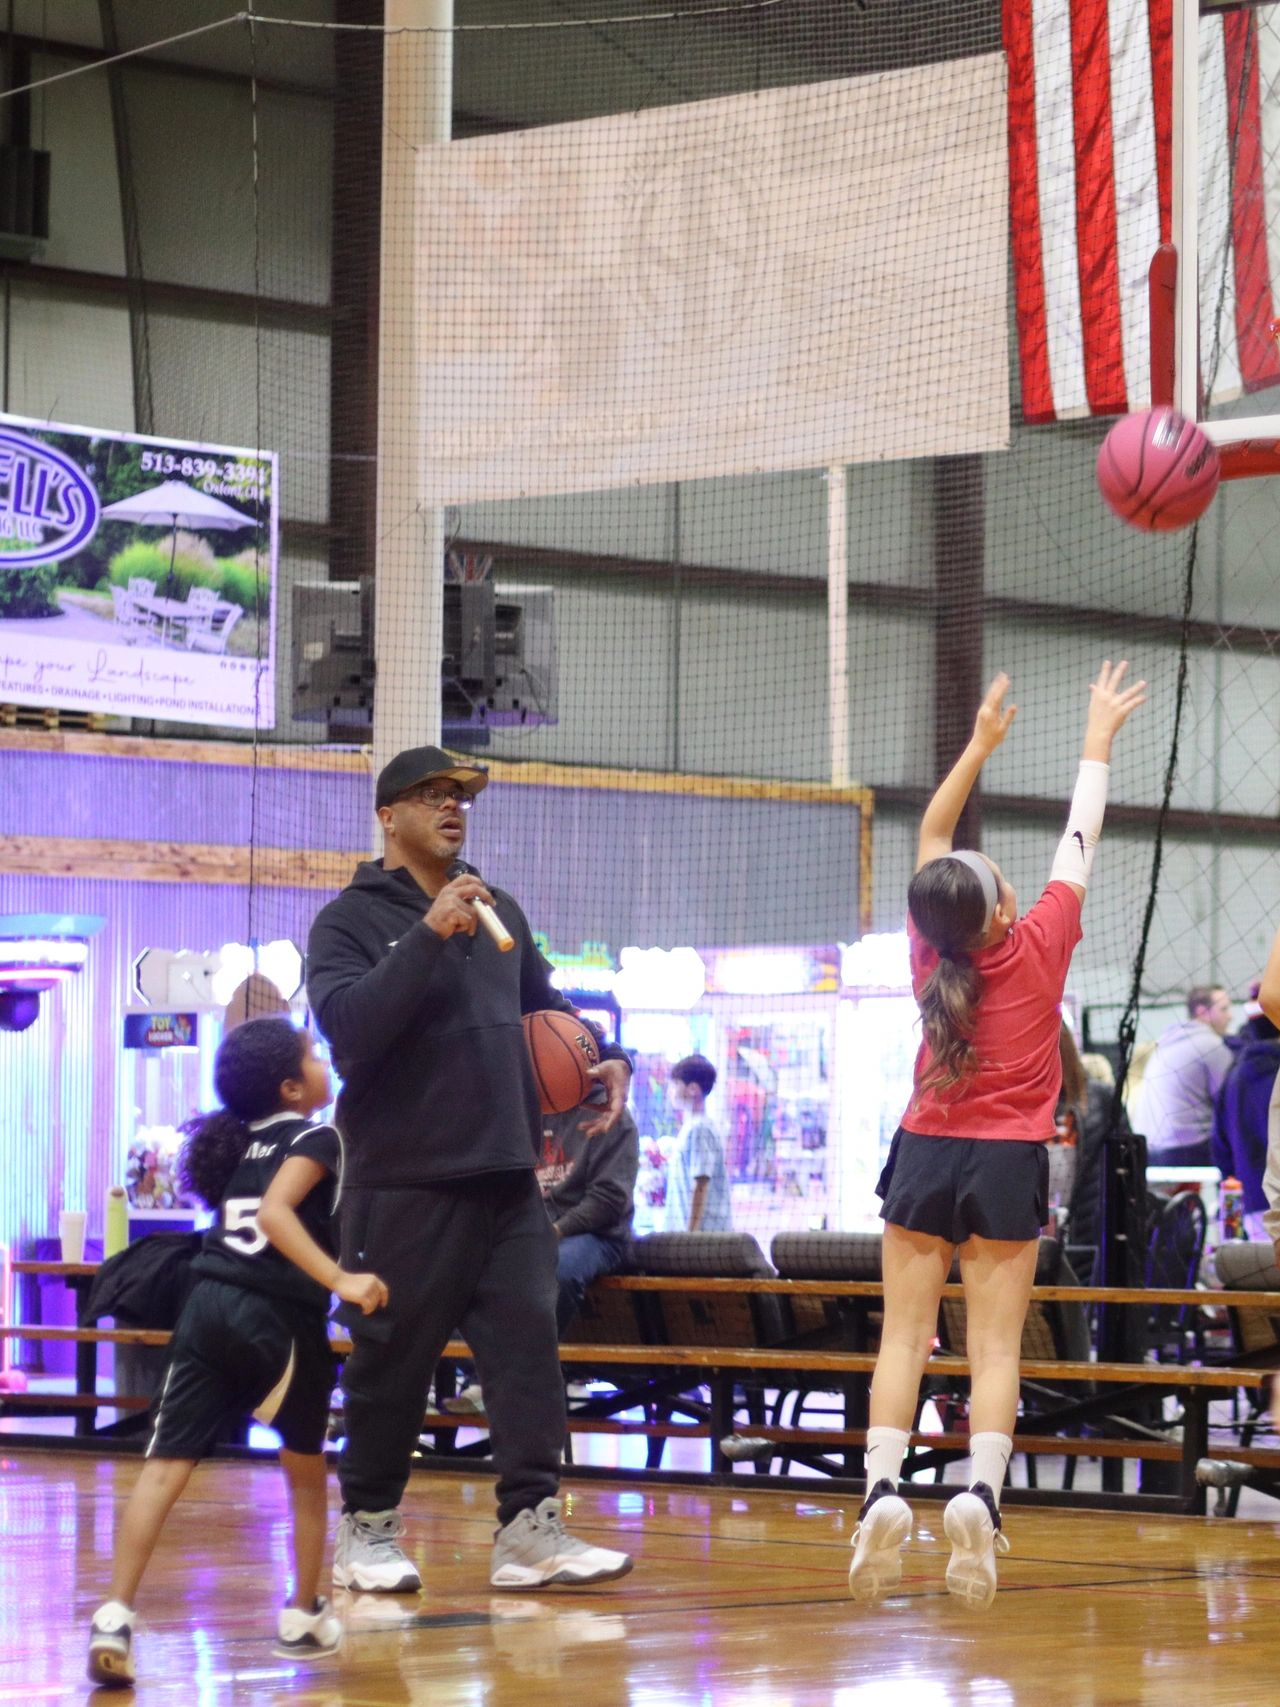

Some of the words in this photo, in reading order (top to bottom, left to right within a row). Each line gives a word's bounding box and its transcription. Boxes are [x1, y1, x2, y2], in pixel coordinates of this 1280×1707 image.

[0, 680, 43, 695] EATURES
[51, 686, 101, 700] DRAINAGE
[108, 692, 153, 707] LIGHTING
[160, 696, 186, 709] POND
[223, 1198, 269, 1255] 5
